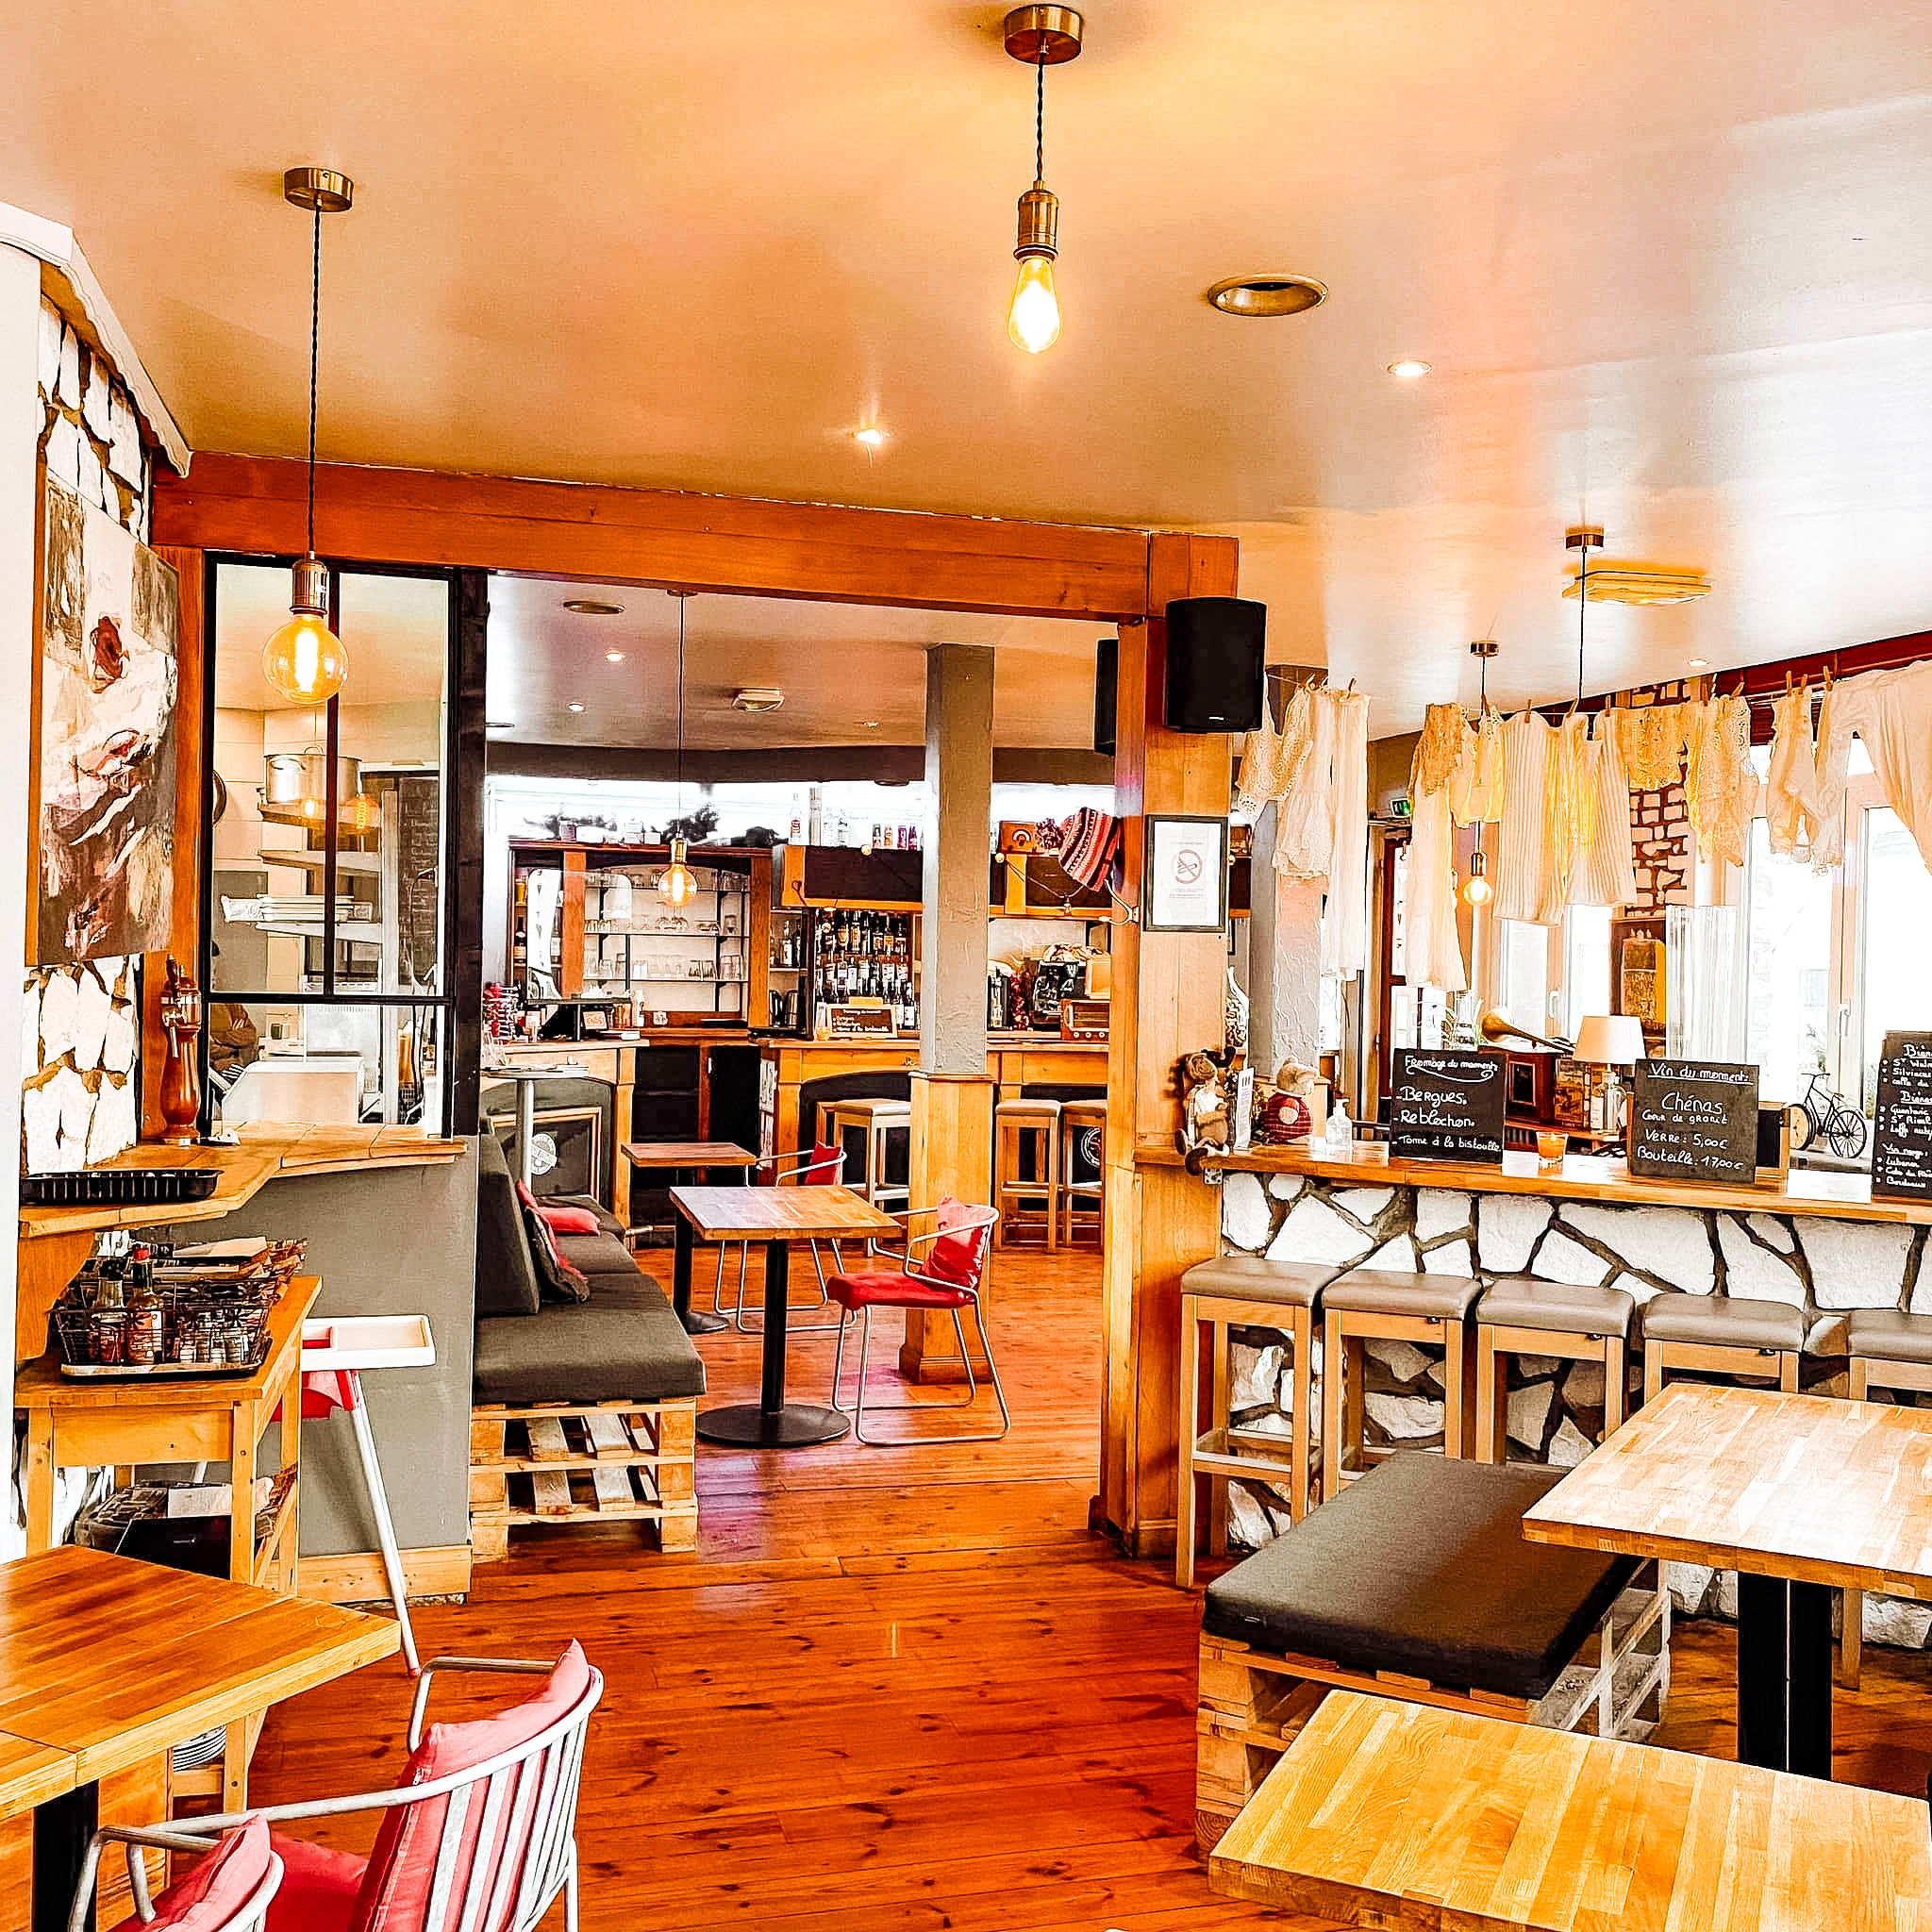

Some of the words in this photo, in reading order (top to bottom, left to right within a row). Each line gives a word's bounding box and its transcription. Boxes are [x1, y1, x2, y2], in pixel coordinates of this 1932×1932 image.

[1447, 1058, 1458, 1068] du
[1650, 1062, 1674, 1076] Vin
[1679, 1065, 1696, 1078] du
[1661, 1091, 1724, 1114] Chénas
[1672, 1113, 1683, 1123] de
[1432, 1136, 1440, 1146] à
[1444, 1136, 1454, 1147] la
